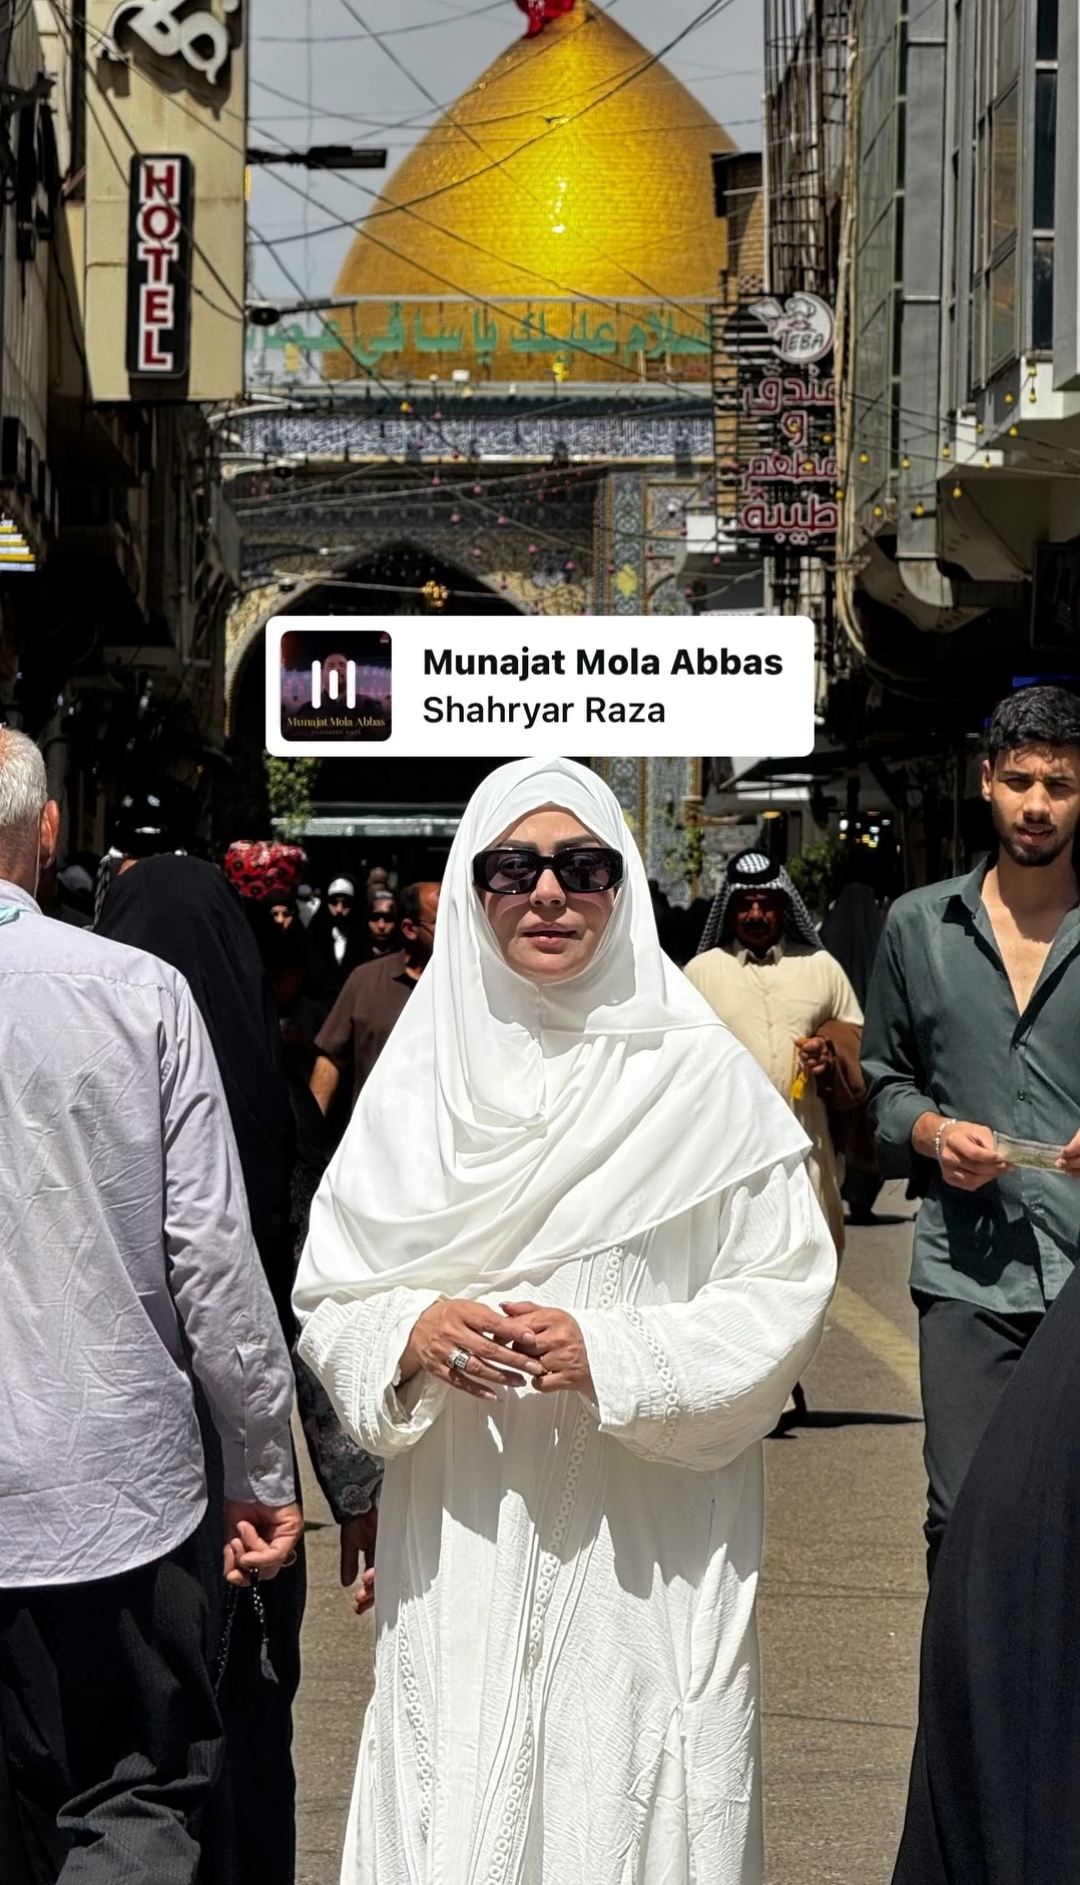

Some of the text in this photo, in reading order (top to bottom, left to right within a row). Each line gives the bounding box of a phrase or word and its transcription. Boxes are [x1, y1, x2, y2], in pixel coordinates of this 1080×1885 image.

[136, 159, 181, 371] HOTEL
[779, 329, 824, 352] TEBA
[781, 411, 808, 447] و
